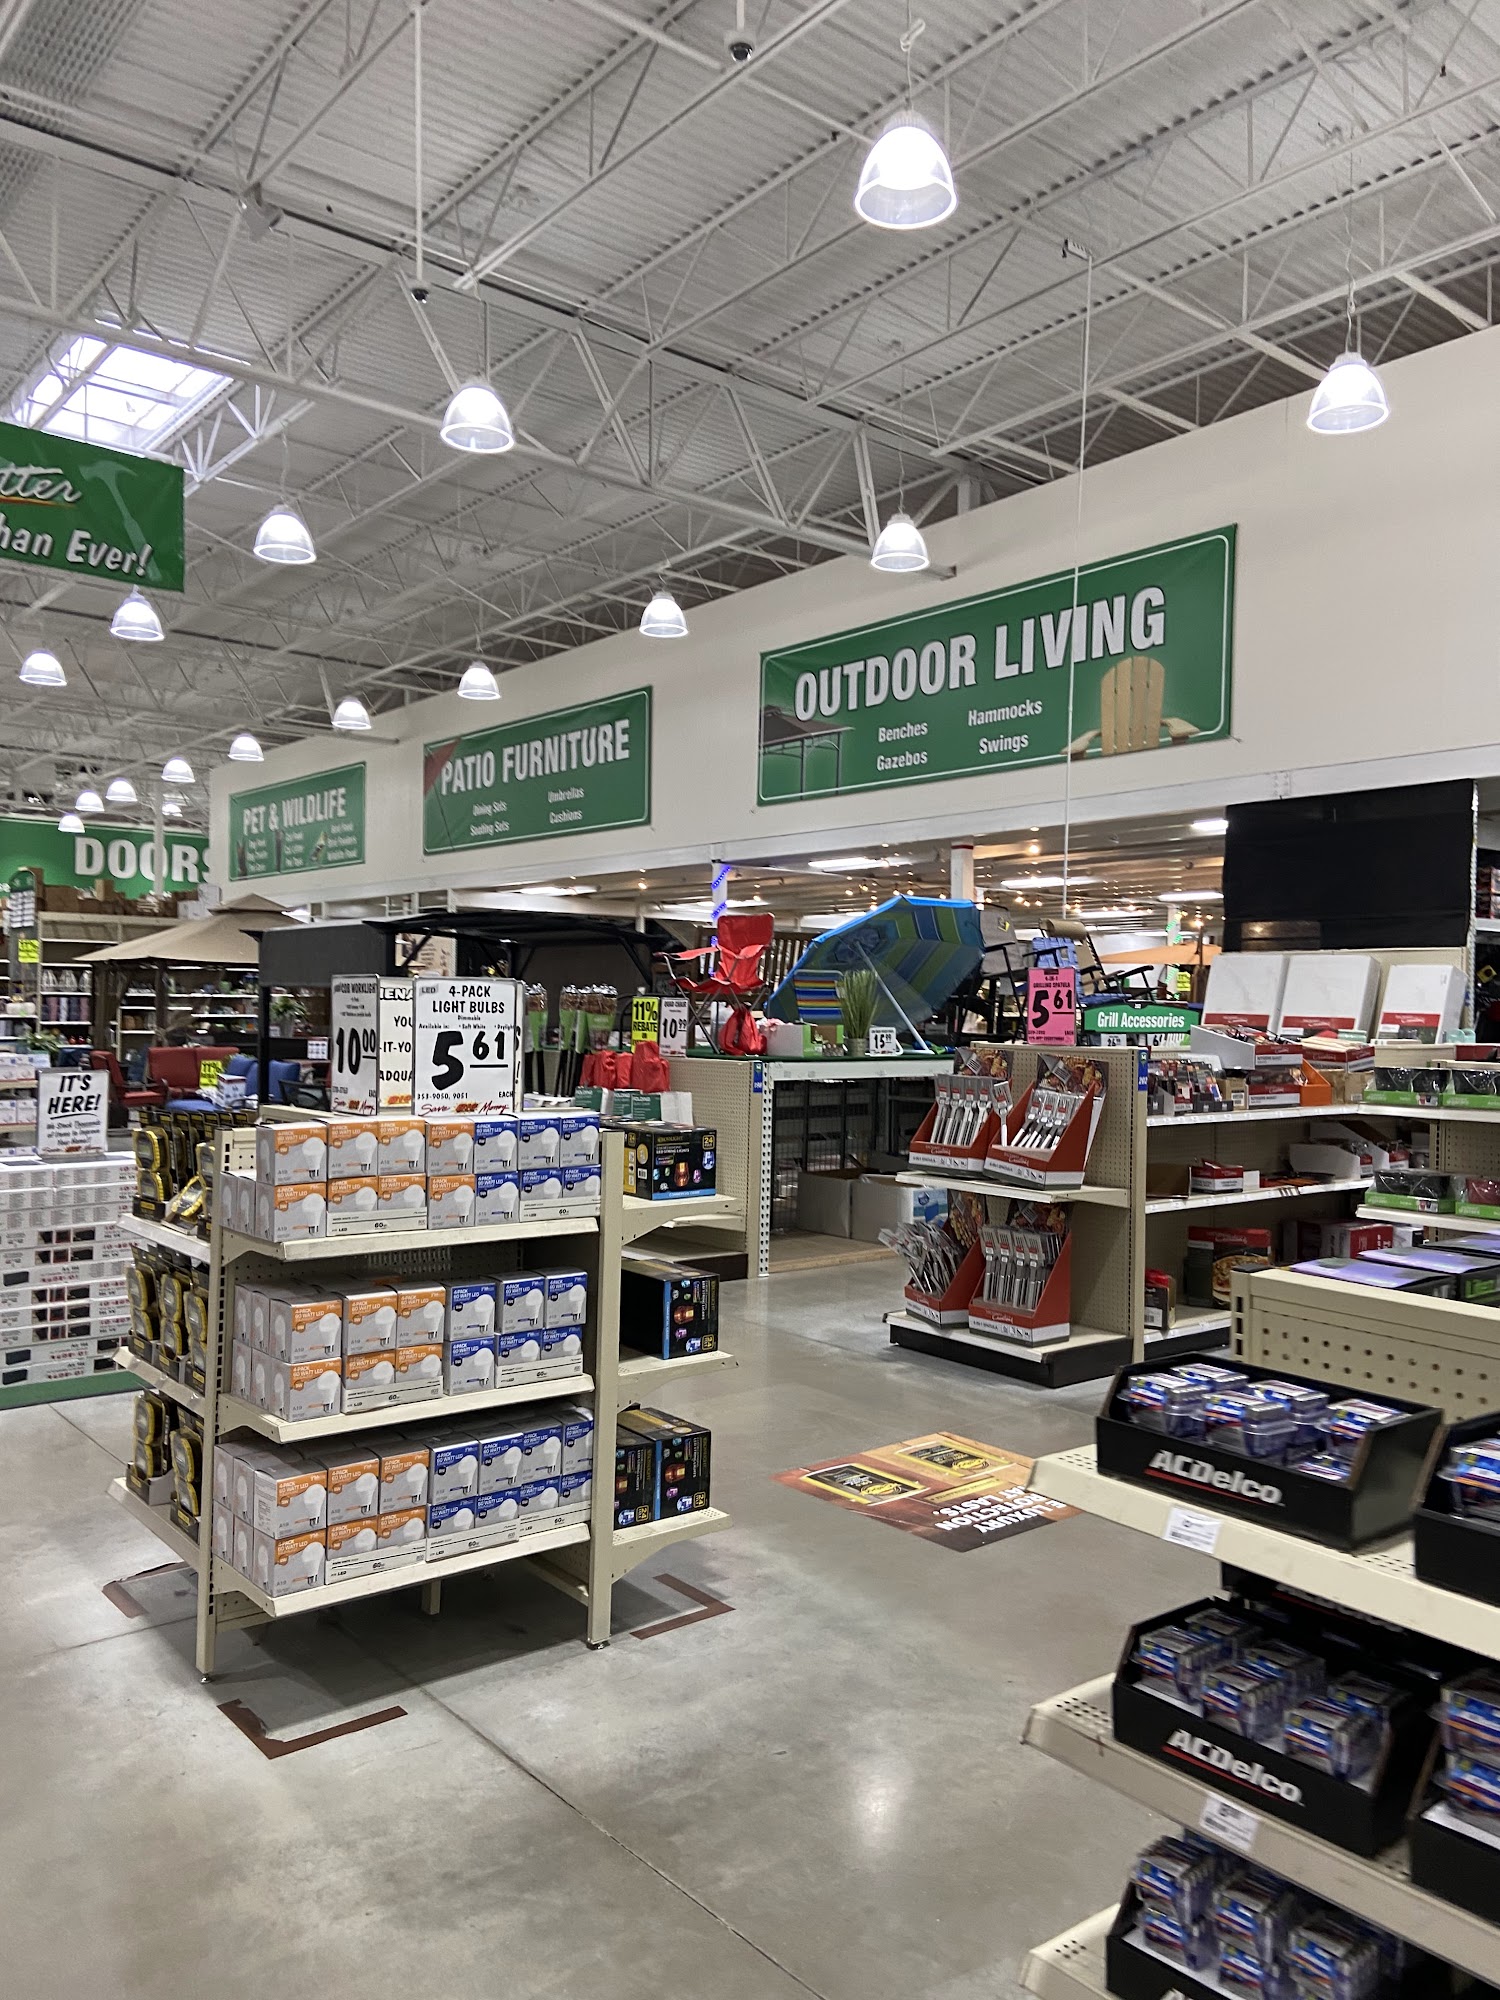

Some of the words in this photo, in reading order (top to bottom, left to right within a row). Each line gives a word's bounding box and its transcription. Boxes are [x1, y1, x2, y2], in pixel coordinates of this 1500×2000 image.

[66, 529, 153, 577] Ever!
[794, 633, 977, 723] OUTDOOR
[994, 585, 1166, 680] LIVING
[967, 698, 1043, 727] Hammocks
[878, 720, 928, 744] Benches
[978, 731, 1030, 756] Swings
[440, 750, 496, 796] PATIO
[502, 718, 630, 783] FURNITURE
[876, 749, 928, 772] Gazebos
[548, 787, 585, 803] Umbrellas
[243, 805, 266, 836] PET
[268, 802, 279, 832] &
[282, 787, 347, 828] WILDLIFE
[550, 809, 583, 824] Cushions
[74, 836, 209, 883] DOOR
[449, 985, 491, 998] 4-PACK
[433, 1000, 466, 1013] LIGHT
[469, 1001, 505, 1014] BULBS
[634, 1001, 658, 1021] 11%
[633, 1022, 658, 1032] REBATE
[1097, 1011, 1119, 1028] Grill
[1121, 1012, 1185, 1029] Accessories
[431, 1030, 464, 1091] 5
[472, 1031, 505, 1060] 61
[59, 1074, 92, 1093] IT'S
[47, 1094, 102, 1115] HERE!
[418, 1104, 450, 1117] Save
[479, 1101, 509, 1115] Money
[1149, 1449, 1283, 1505] ACDelco
[933, 1494, 1004, 1517] LASTS.
[973, 1504, 1054, 1534] LUXURY
[1166, 1728, 1303, 1802] ACDelco
